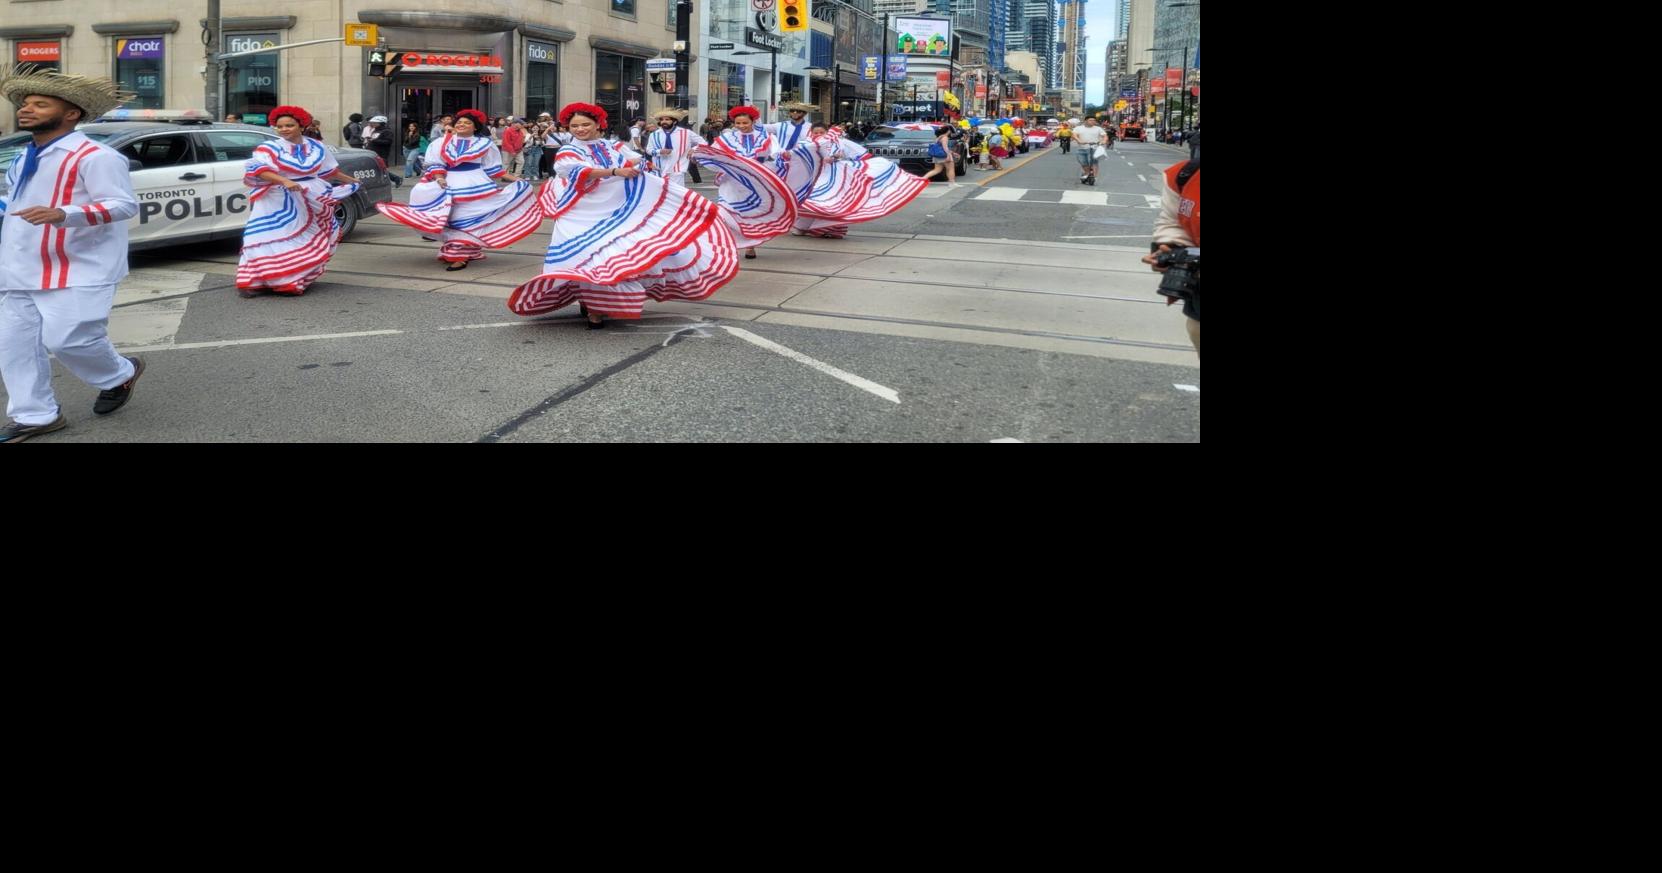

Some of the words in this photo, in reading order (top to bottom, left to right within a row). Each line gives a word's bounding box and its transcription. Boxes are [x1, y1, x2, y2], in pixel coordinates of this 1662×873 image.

[231, 38, 261, 52] fido
[752, 31, 765, 45] Foot
[765, 34, 782, 49] Locker
[29, 47, 59, 55] ROGERS
[528, 45, 546, 59] fido
[426, 53, 502, 67] ROGERS
[137, 75, 156, 85] $15
[353, 169, 376, 179] 6933
[137, 188, 196, 201] TORONTO
[139, 194, 253, 224] POLIC
